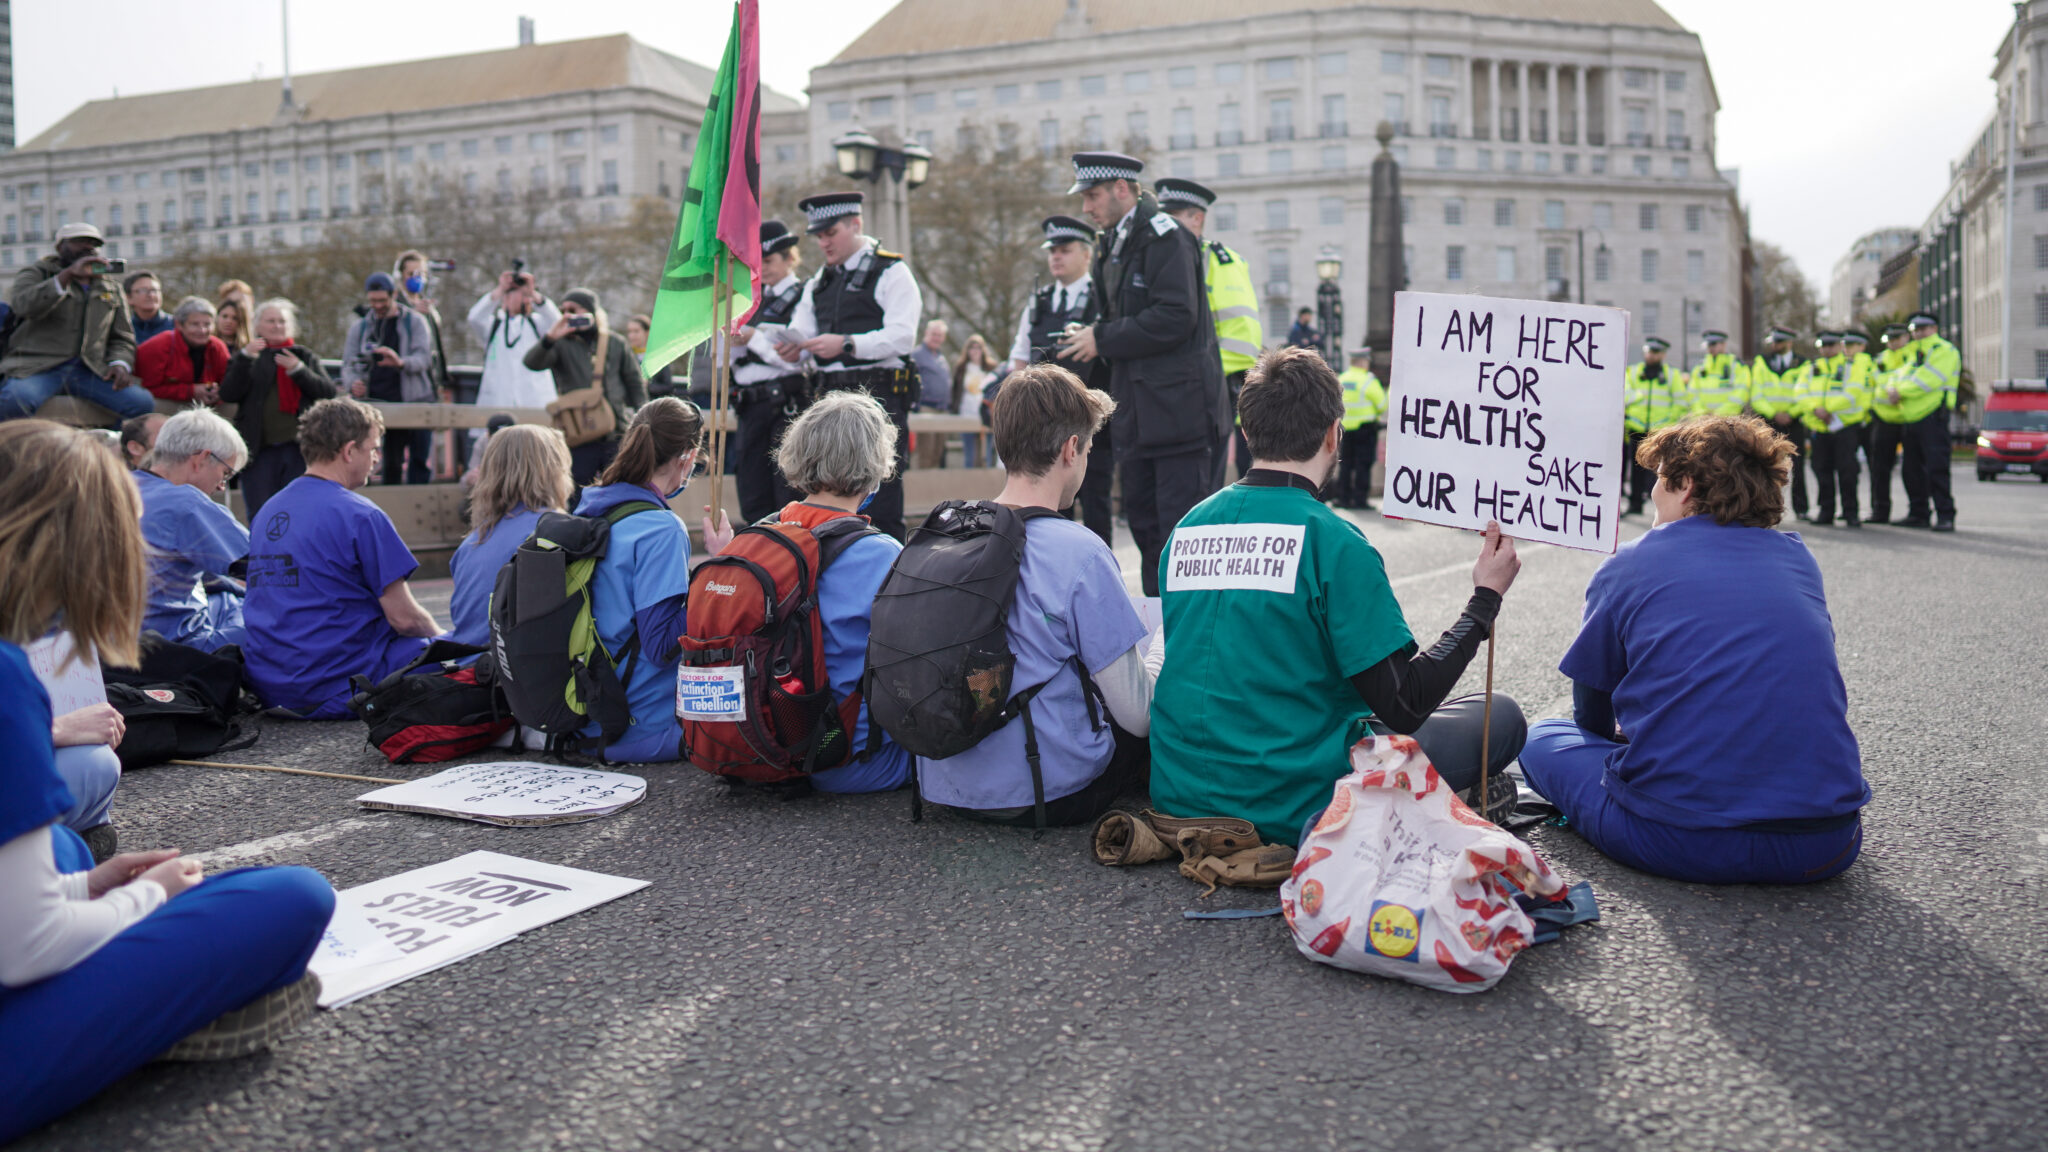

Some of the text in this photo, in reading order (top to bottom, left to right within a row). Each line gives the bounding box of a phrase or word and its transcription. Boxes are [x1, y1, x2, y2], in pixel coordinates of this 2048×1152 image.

[1416, 306, 1606, 370] I AM HERE
[1478, 361, 1541, 406] FOR
[1400, 394, 1546, 453] HEALTH'S
[1526, 453, 1603, 498] SAKE
[1393, 465, 1601, 540] OUR HEALTH
[1173, 536, 1297, 557] PROTESTING FOR
[1176, 558, 1285, 578] PUBLIC HEALTH
[682, 682, 725, 696] extinction
[691, 695, 738, 711] rebellion
[362, 892, 502, 928] FUELS
[426, 877, 550, 908] NOW
